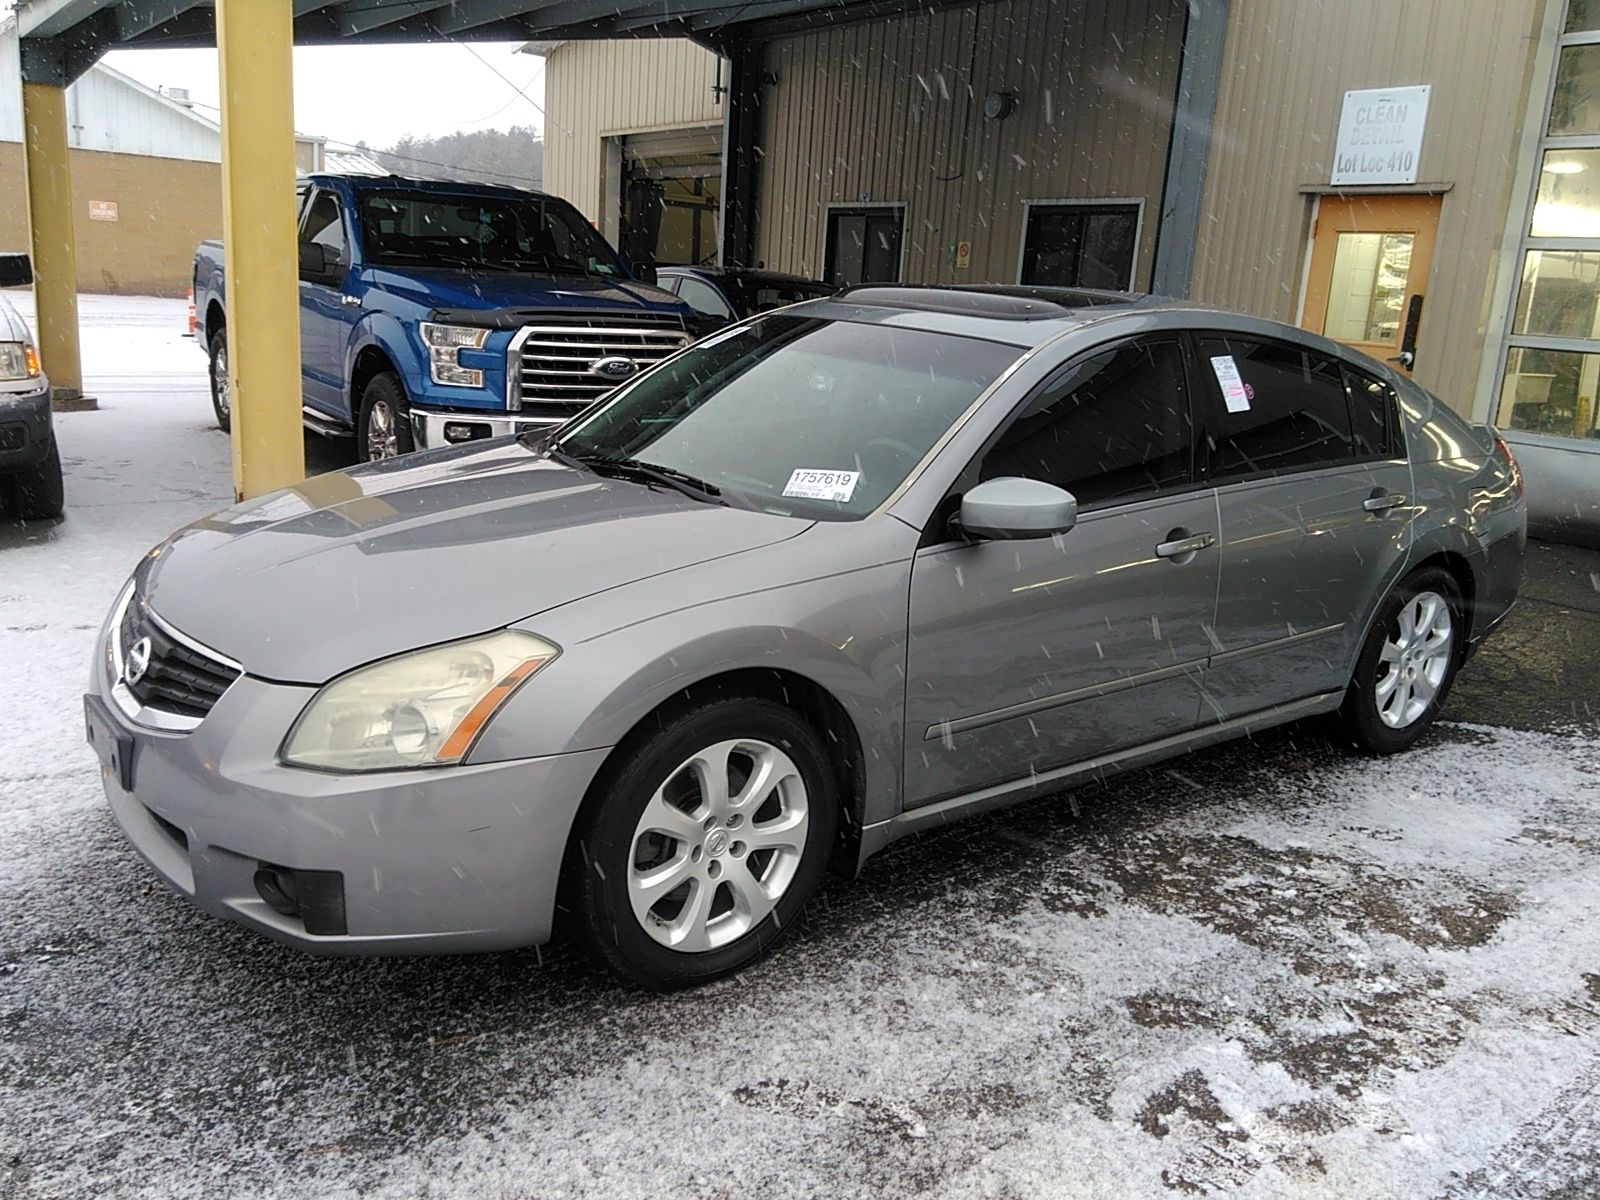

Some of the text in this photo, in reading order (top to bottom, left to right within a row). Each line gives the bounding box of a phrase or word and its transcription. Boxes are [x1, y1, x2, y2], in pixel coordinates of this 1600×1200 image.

[1356, 104, 1408, 126] CLEAN
[1337, 150, 1414, 174] Lot Loc 410
[607, 362, 630, 374] Ford
[793, 471, 851, 486] 1757619
